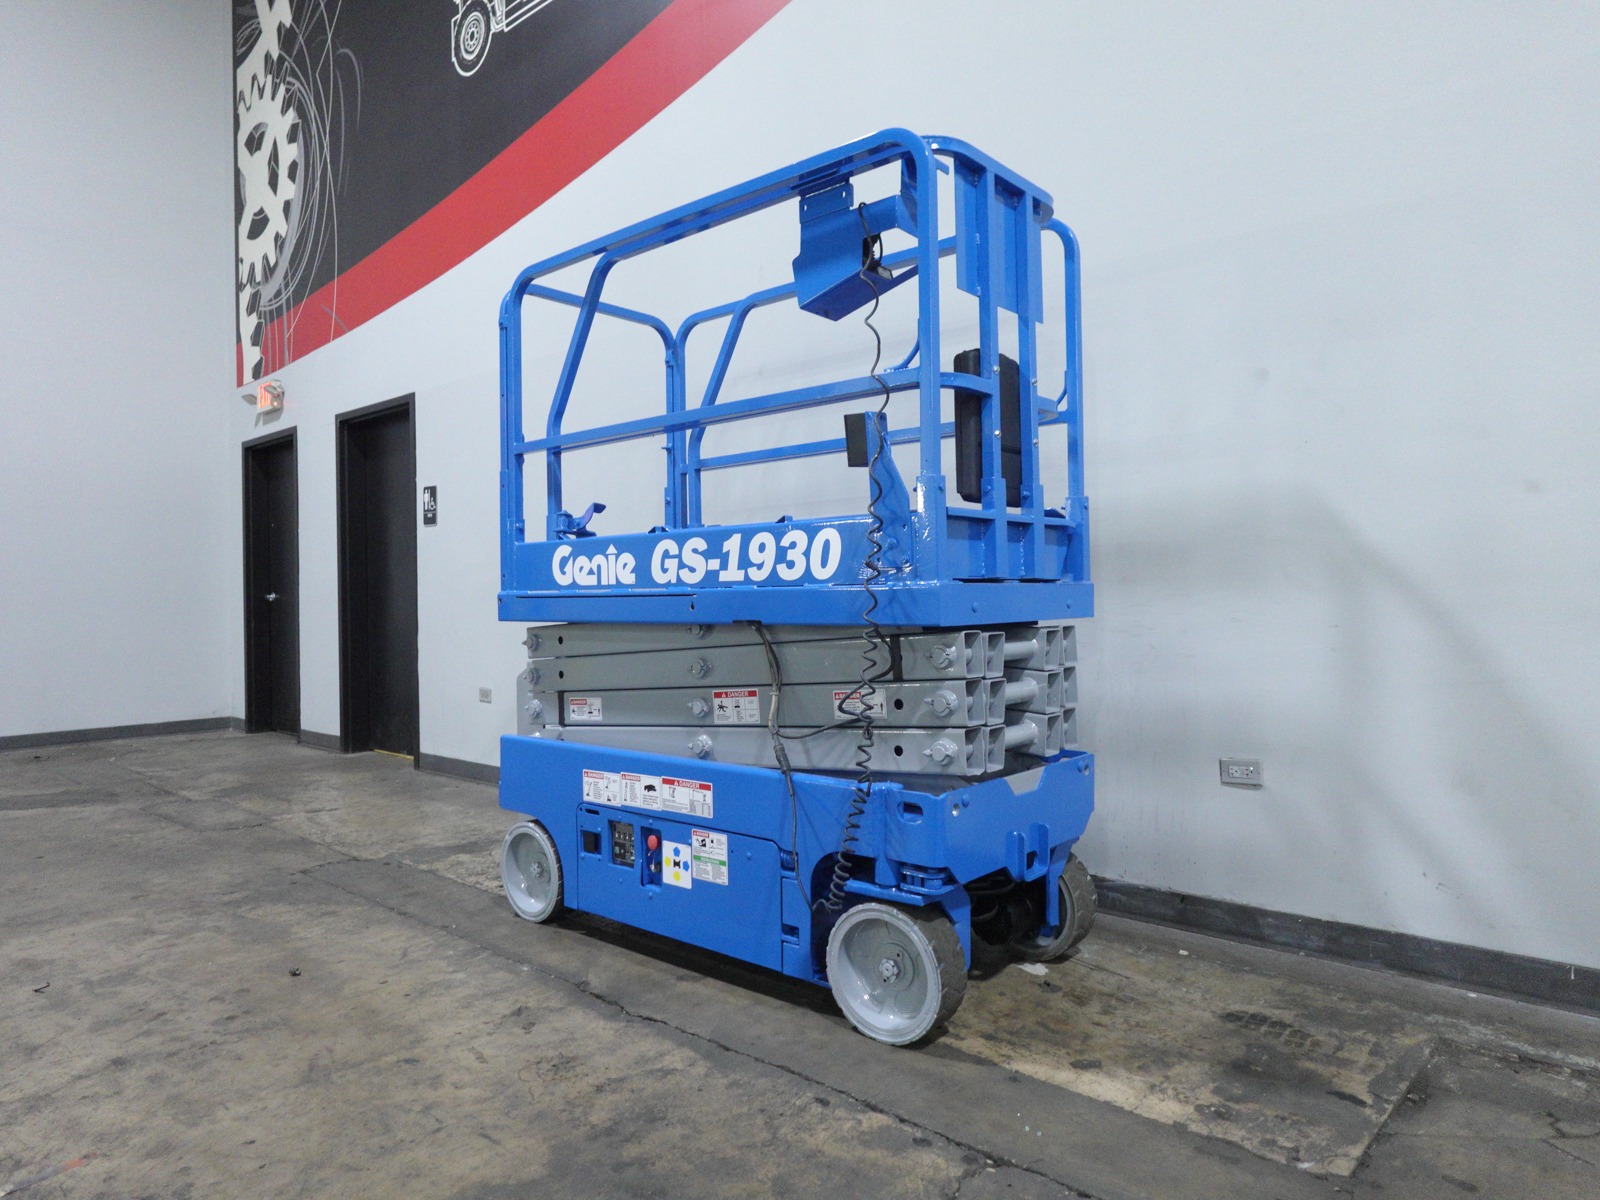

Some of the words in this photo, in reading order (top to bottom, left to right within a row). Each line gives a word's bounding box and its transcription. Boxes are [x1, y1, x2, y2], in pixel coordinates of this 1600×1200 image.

[552, 543, 636, 586] Genie
[651, 527, 842, 585] GS-1930
[727, 690, 749, 698] DANGER
[679, 780, 700, 789] DANGER
